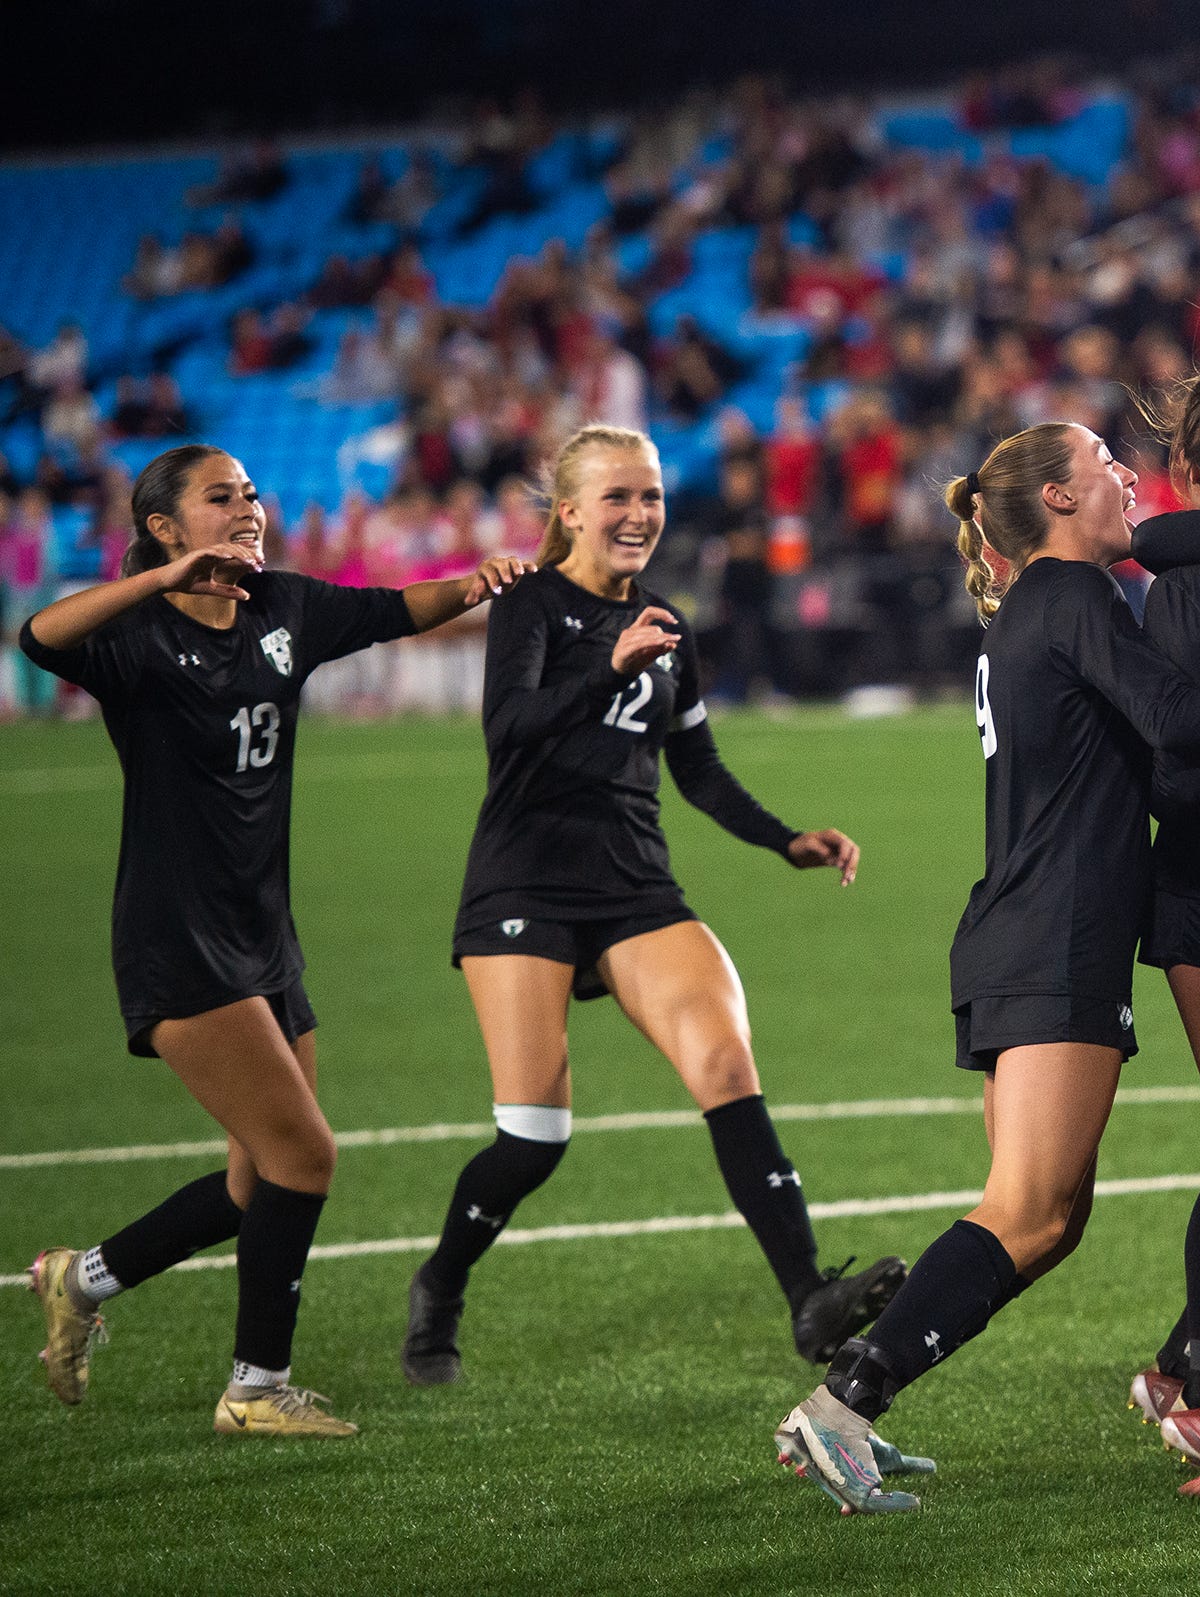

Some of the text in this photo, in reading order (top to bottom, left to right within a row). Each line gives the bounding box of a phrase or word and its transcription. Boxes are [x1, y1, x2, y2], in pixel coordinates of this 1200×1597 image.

[230, 702, 280, 773] 13
[603, 671, 653, 733] 12
[975, 653, 998, 760] 9
